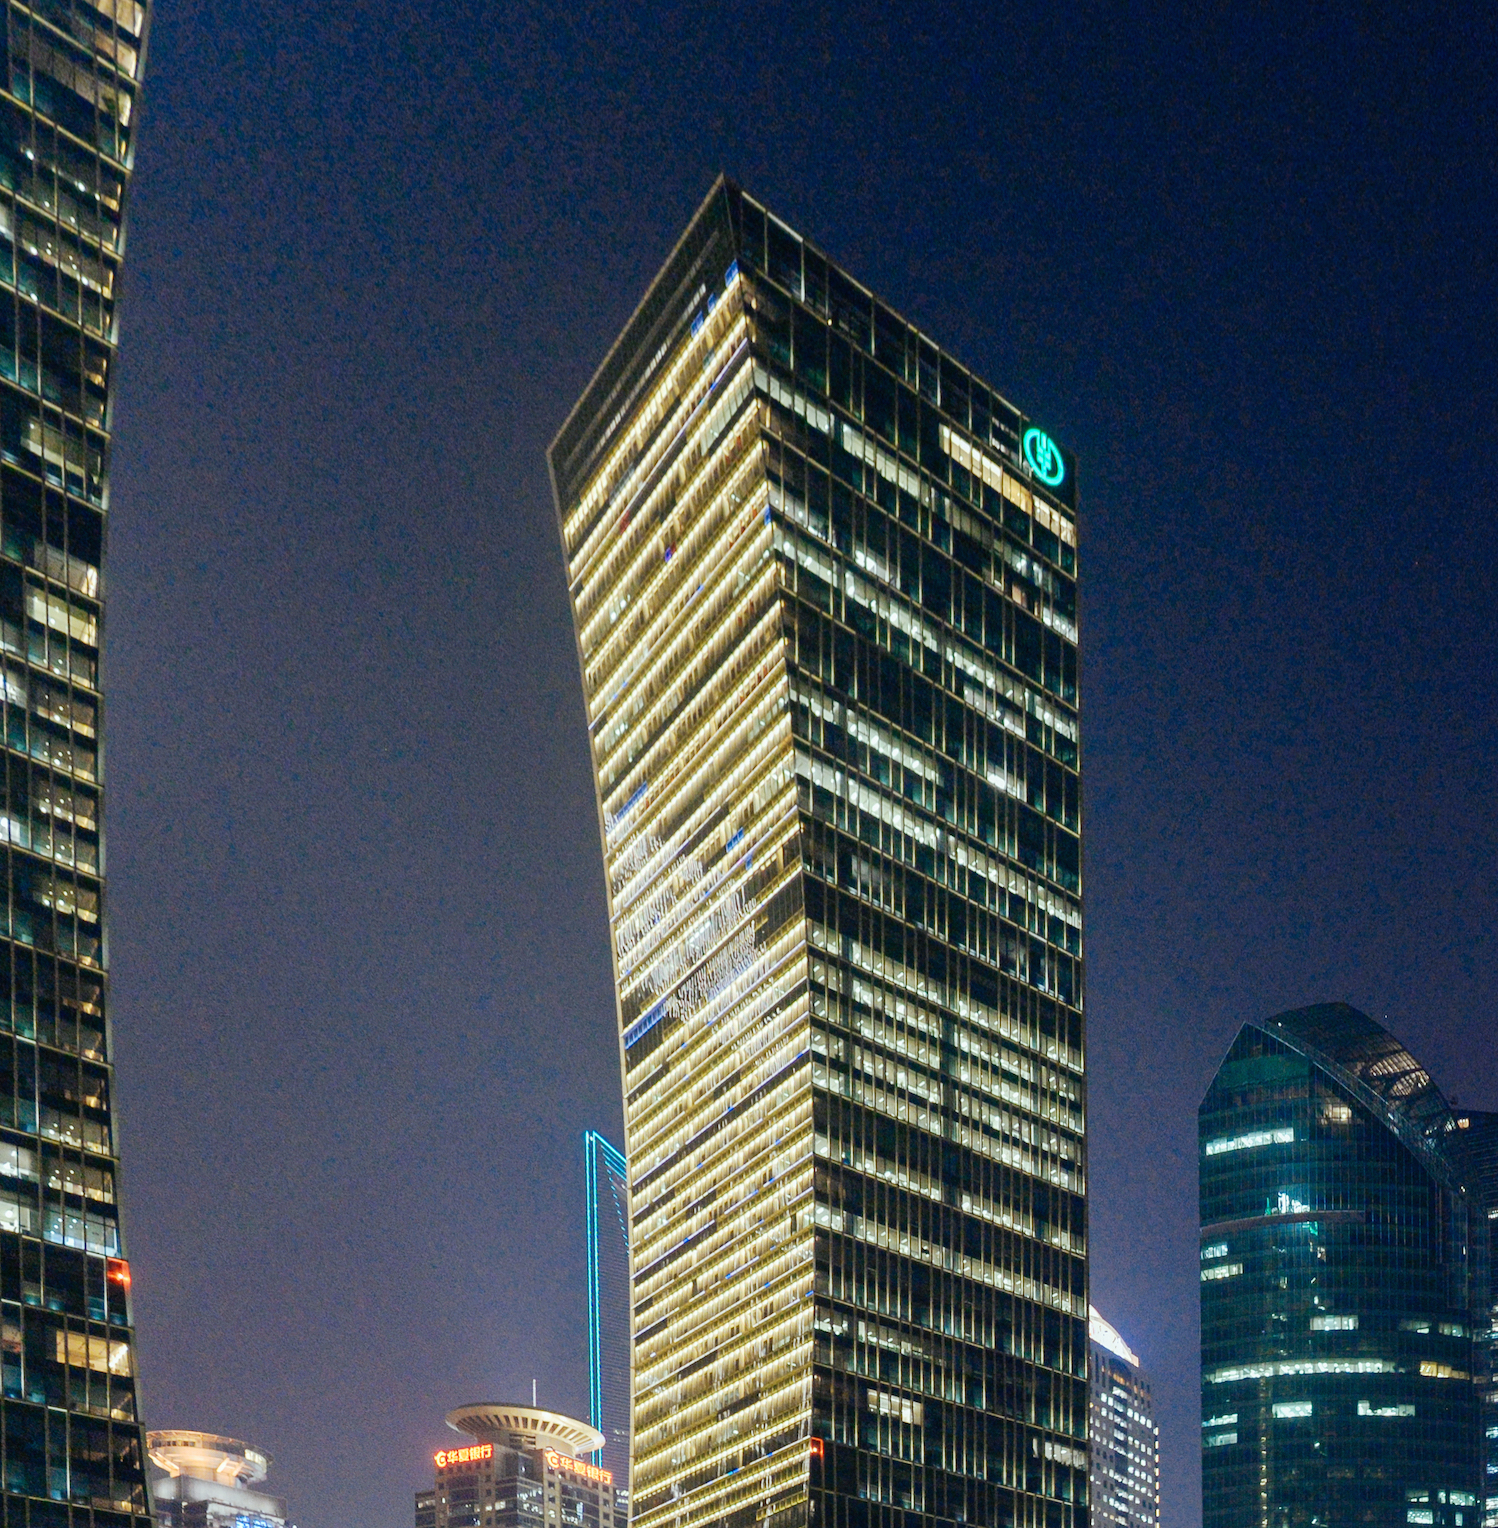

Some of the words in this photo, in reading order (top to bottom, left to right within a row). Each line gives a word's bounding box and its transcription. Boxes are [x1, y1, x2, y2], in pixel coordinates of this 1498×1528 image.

[446, 1444, 493, 1464] 华夏银行
[560, 1457, 613, 1485] 华夏银行
